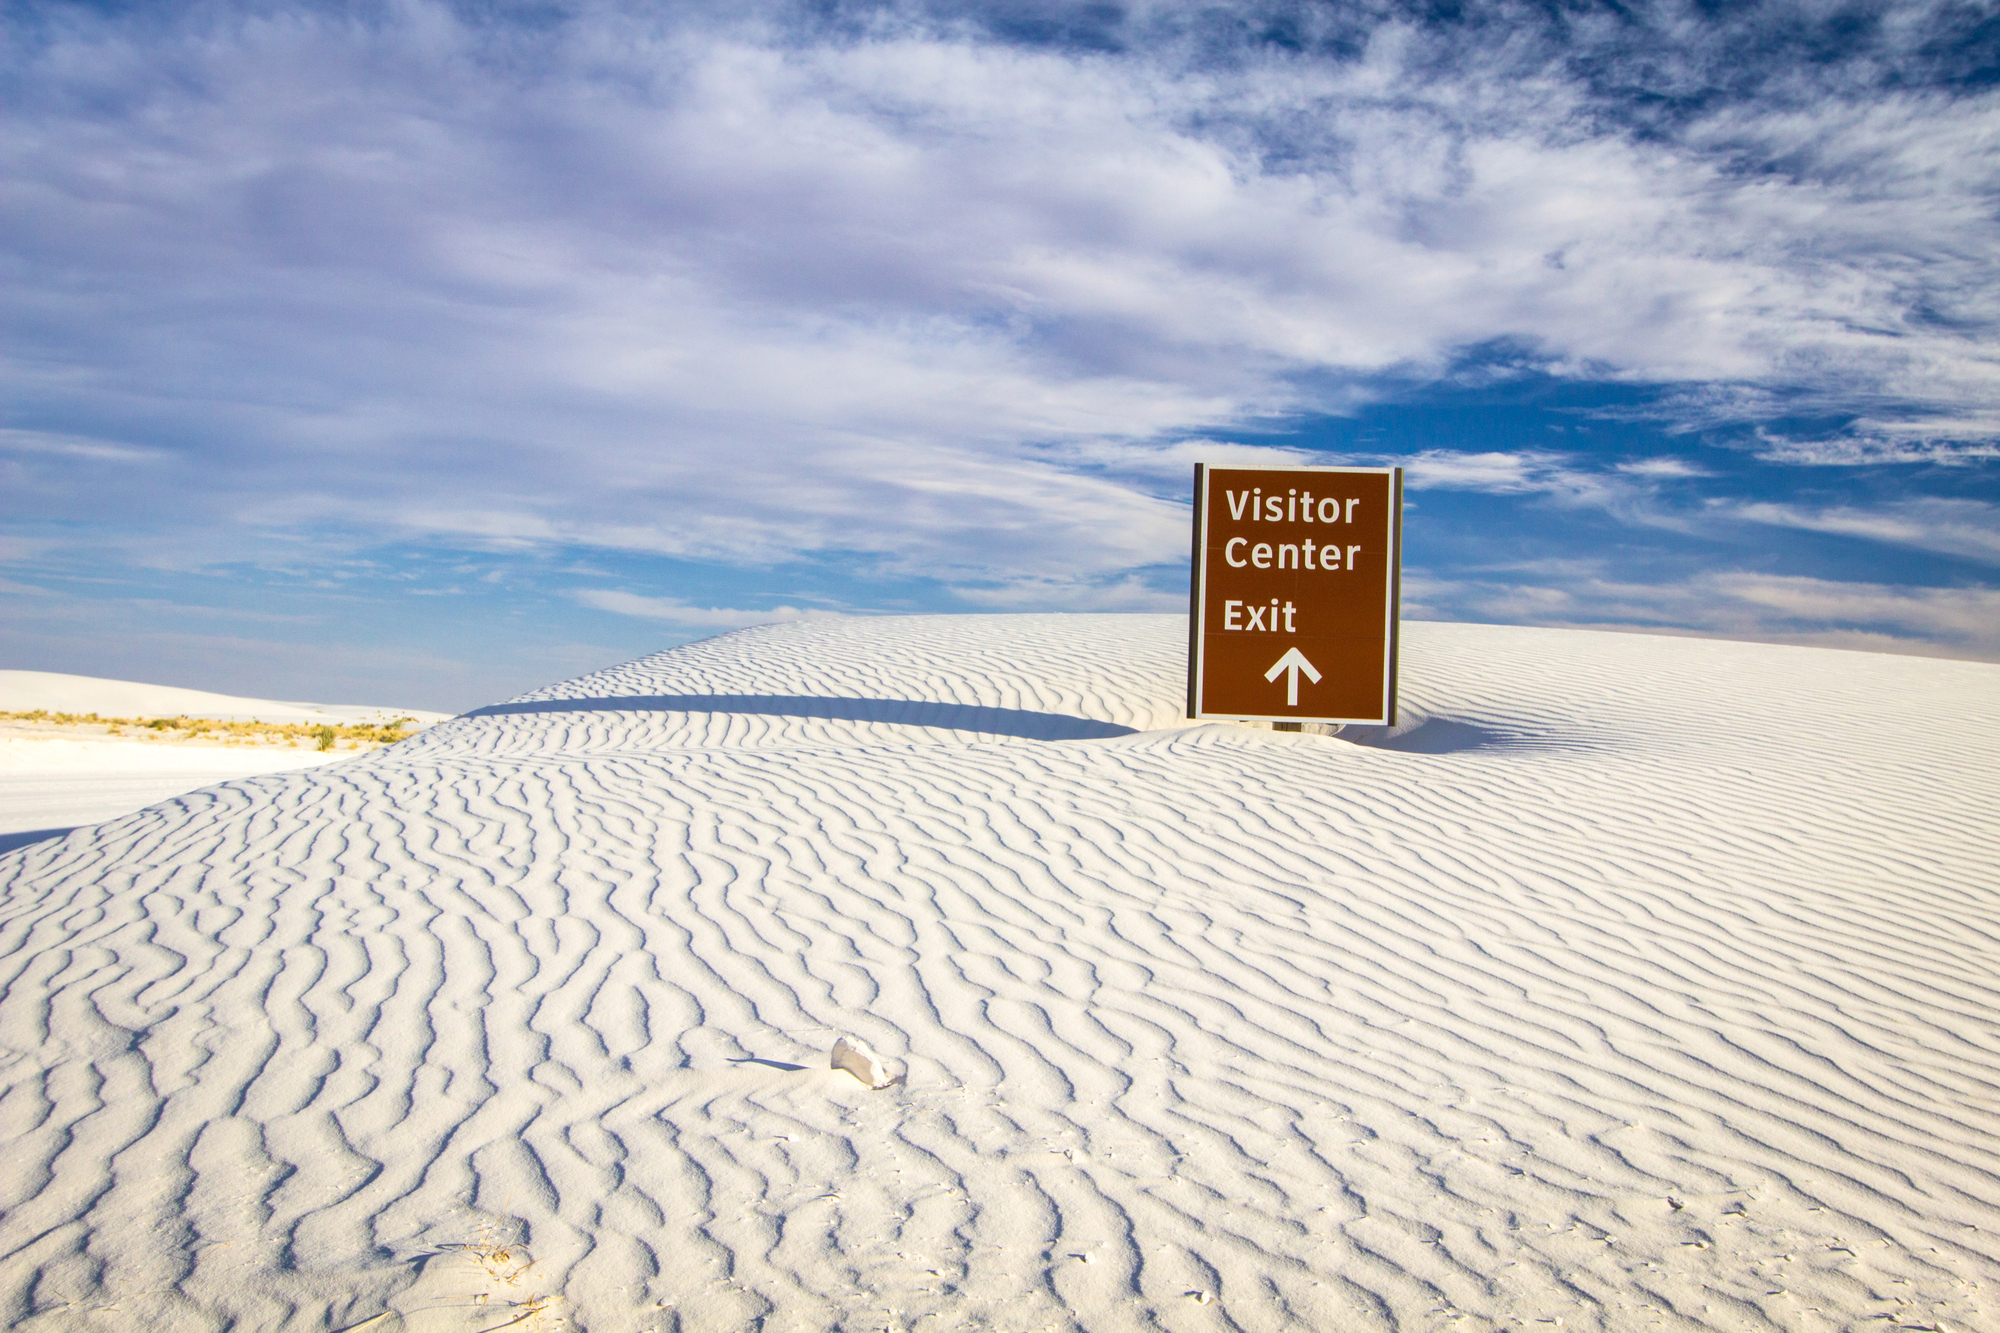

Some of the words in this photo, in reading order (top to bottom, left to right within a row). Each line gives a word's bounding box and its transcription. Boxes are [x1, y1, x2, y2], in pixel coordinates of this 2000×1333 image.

[1226, 488, 1360, 524] Visitor
[1225, 537, 1361, 571] Center
[1224, 598, 1297, 633] Exit
